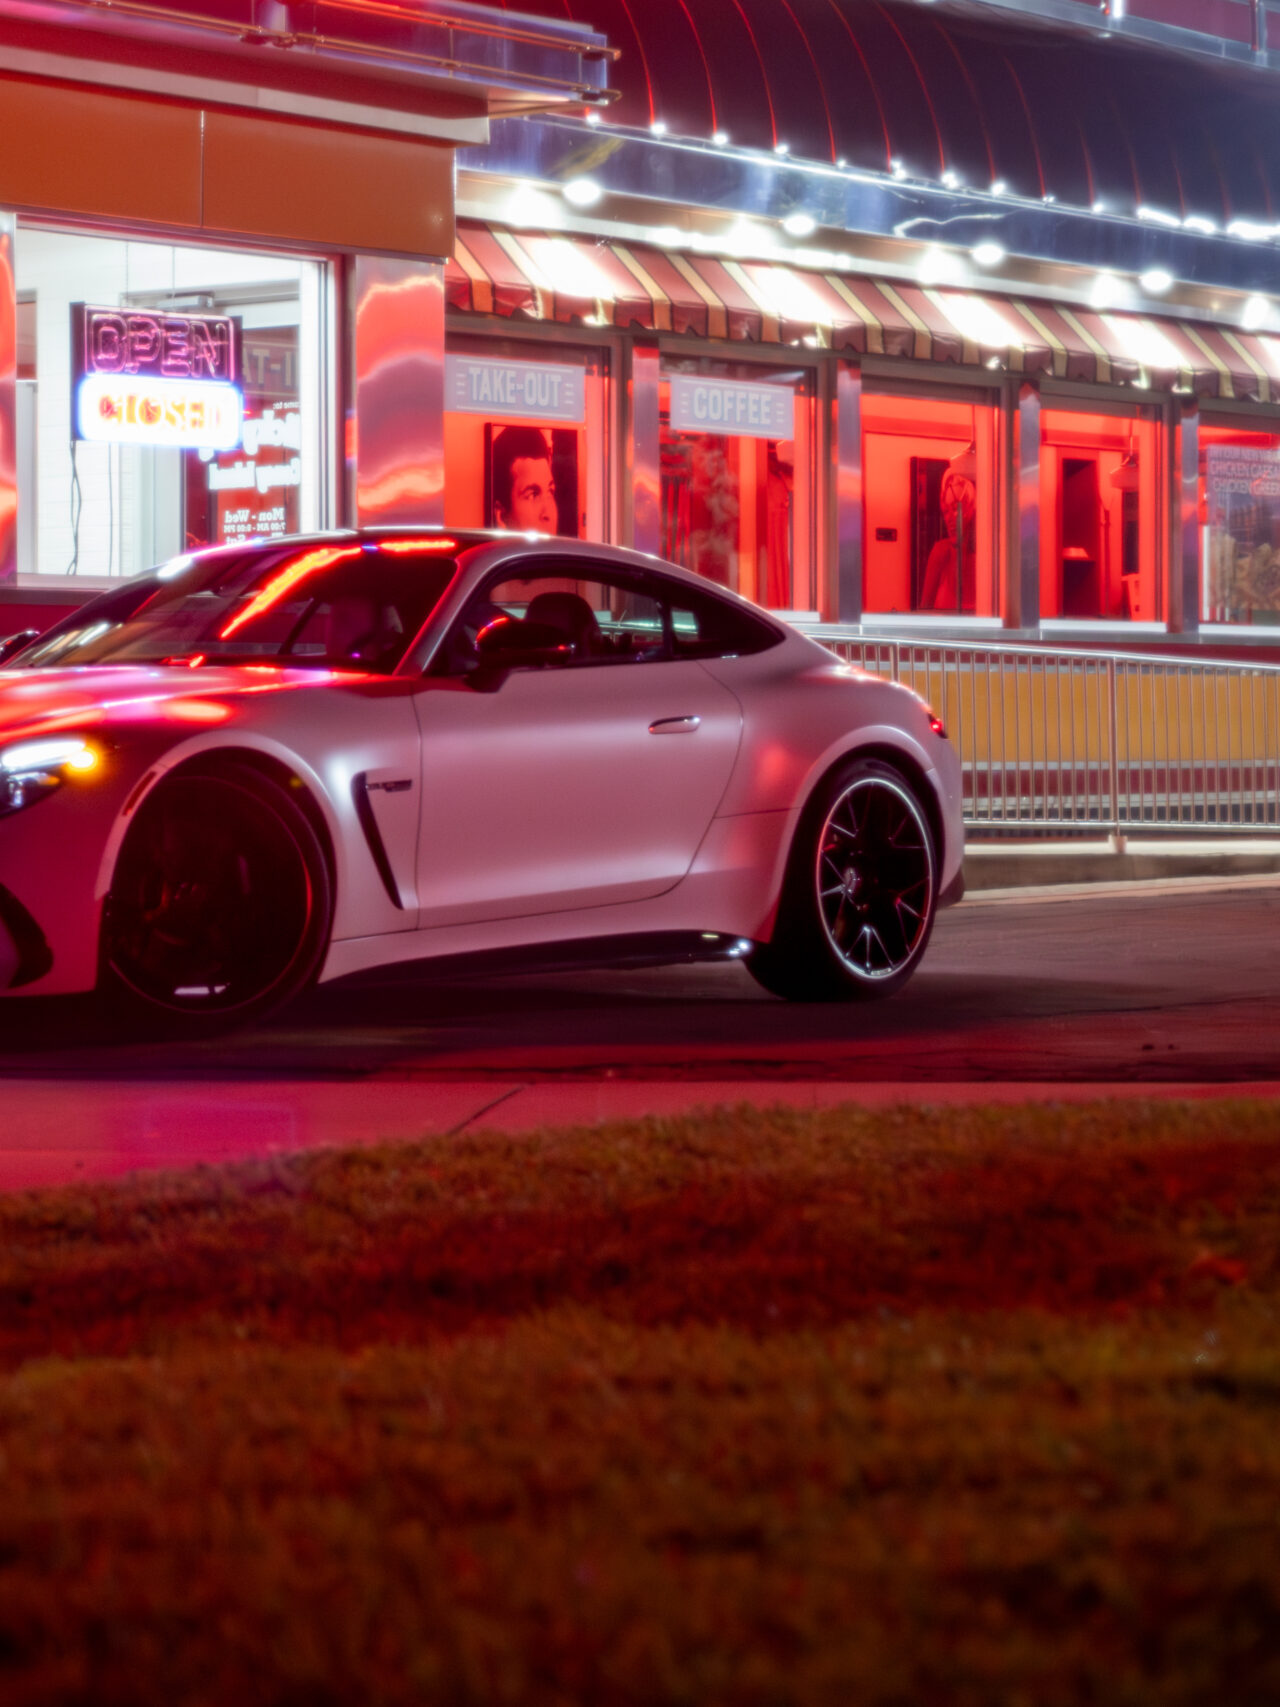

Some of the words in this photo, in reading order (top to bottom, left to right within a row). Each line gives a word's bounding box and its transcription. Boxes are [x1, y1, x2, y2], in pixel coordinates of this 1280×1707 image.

[91, 313, 227, 378] OPEN
[469, 366, 562, 407] TAKE-OUT
[693, 387, 772, 425] COFFEE
[1214, 478, 1250, 494] CHICKEN
